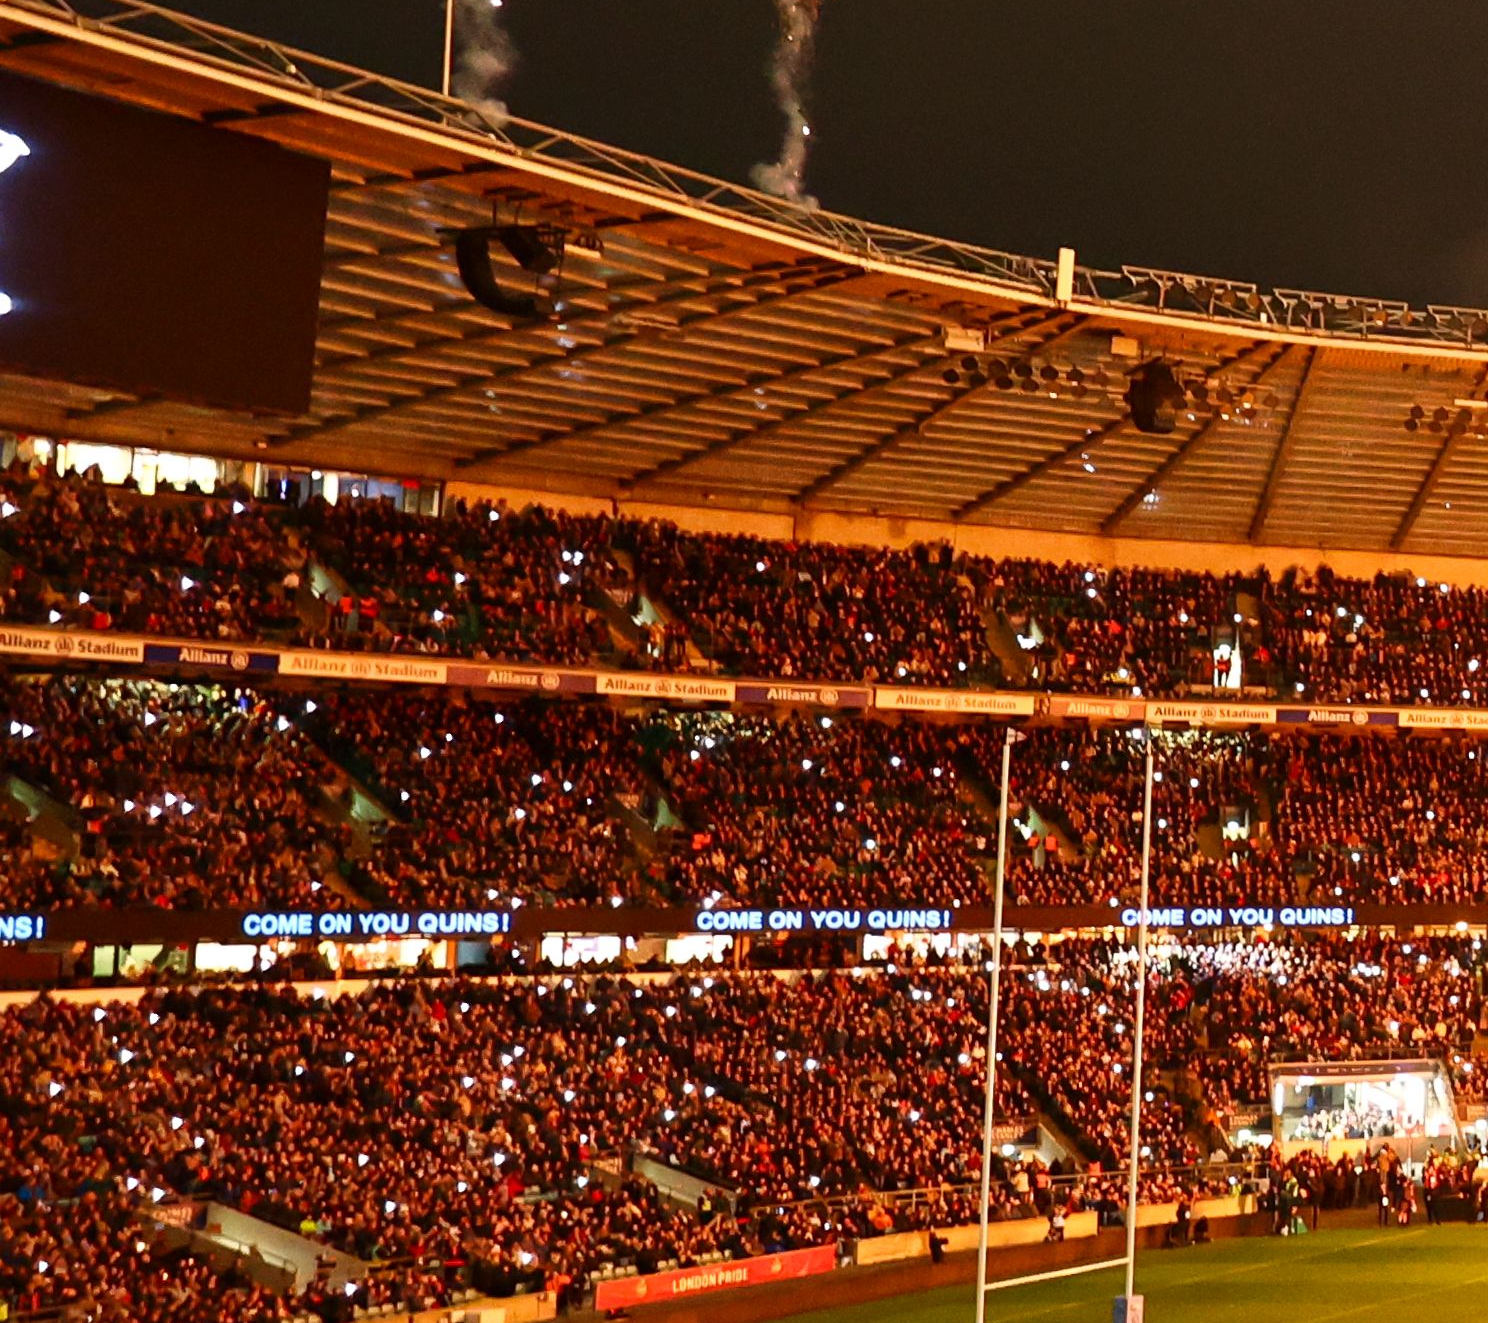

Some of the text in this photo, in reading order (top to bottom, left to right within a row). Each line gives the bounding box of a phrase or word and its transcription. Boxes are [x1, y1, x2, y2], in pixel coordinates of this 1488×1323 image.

[179, 649, 228, 665] Allianz
[291, 657, 438, 678] Allianz Stadium
[487, 670, 538, 685] Allianz
[605, 677, 727, 696] Allianz Stadium
[767, 687, 817, 701] Allianz
[896, 694, 1016, 710] Allianz Stadium
[1068, 703, 1111, 716] Allianz
[1154, 706, 1269, 720] Allianz Stadium
[1309, 710, 1351, 723] Allianz
[1407, 713, 1447, 724] Allianz
[243, 912, 510, 936] COME ON YOU QUINS!
[697, 910, 950, 930] COME ON YOU QUINS!
[1121, 908, 1353, 926] COME ON YOU QUINS!
[673, 1268, 748, 1293] LONDON PRIDE
